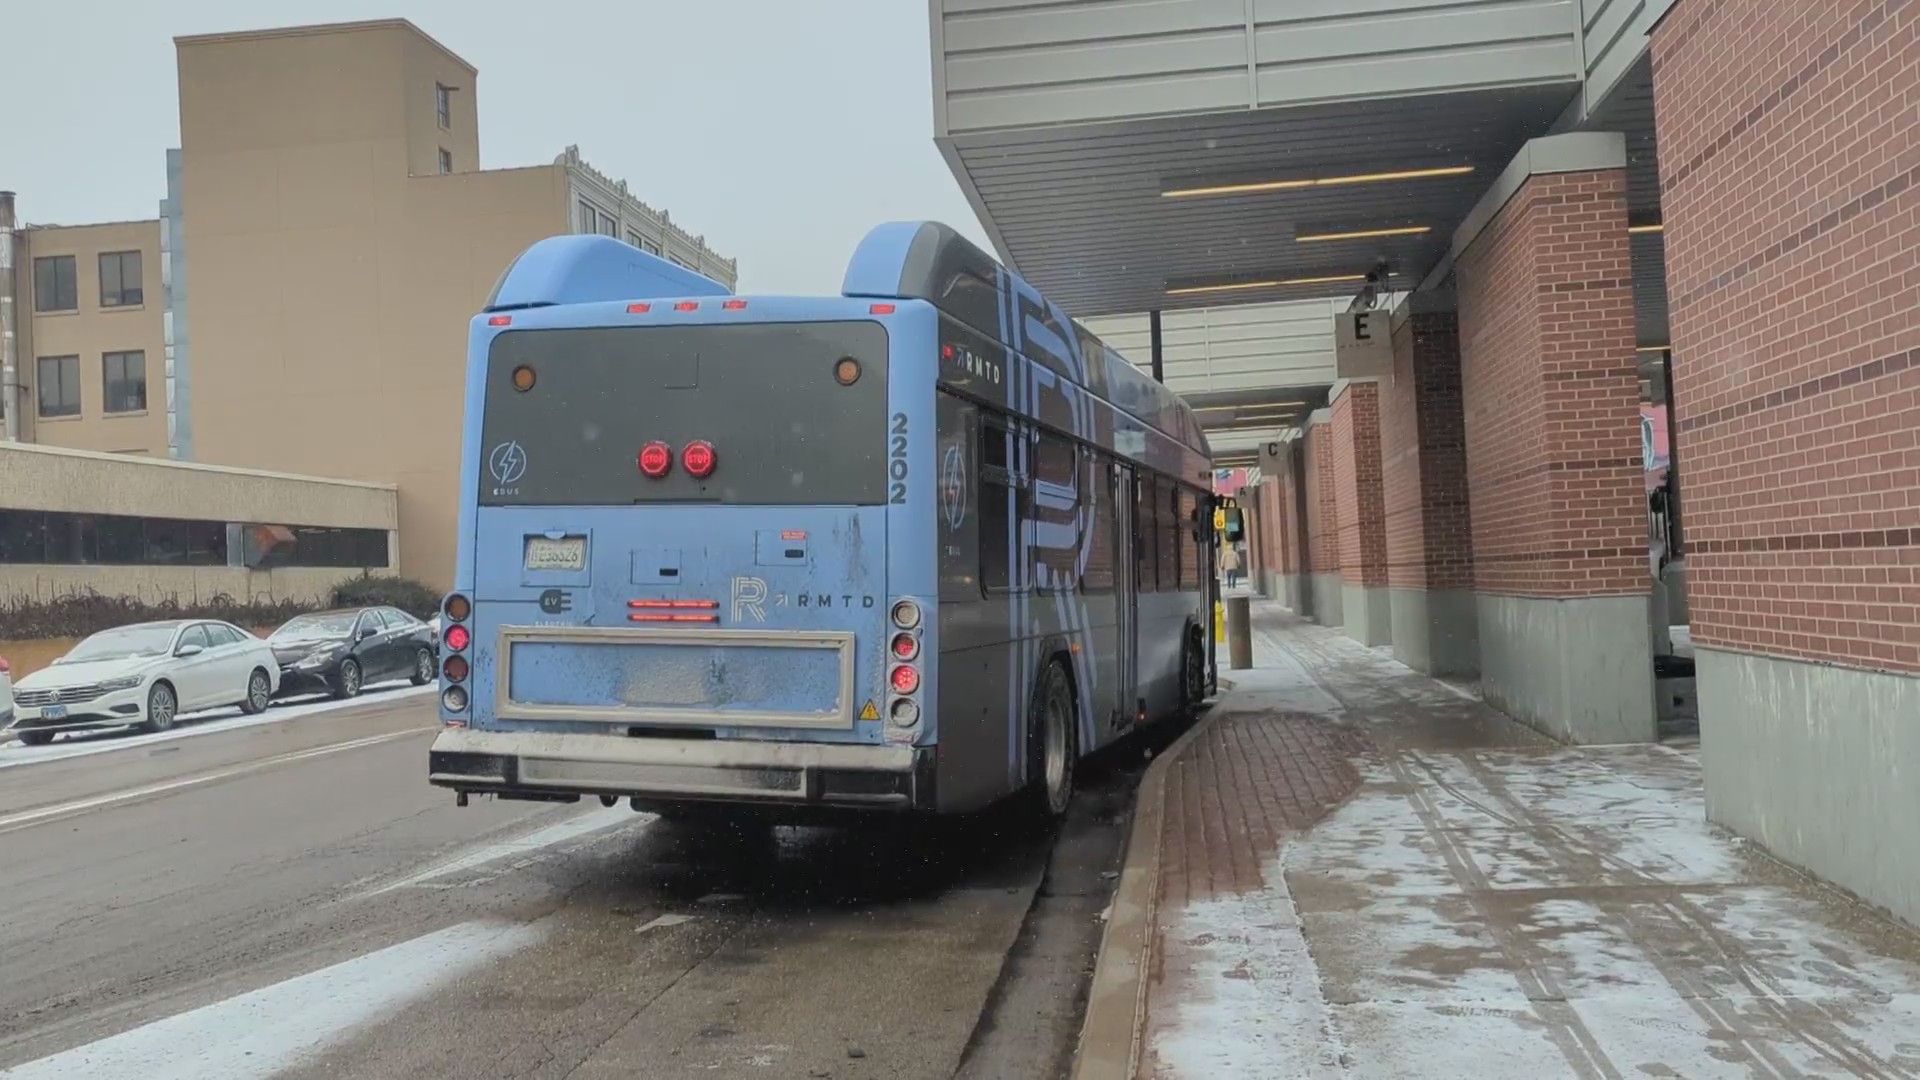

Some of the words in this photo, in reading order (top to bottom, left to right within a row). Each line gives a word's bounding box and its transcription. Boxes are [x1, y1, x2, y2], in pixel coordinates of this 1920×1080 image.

[1354, 312, 1371, 340] E
[966, 351, 1000, 384] RMTD
[1268, 442, 1278, 457] C
[642, 454, 664, 464] STOP
[687, 454, 709, 464] STOP
[890, 412, 908, 505] 2202
[544, 597, 558, 606] EV
[798, 594, 875, 608] RMTD
